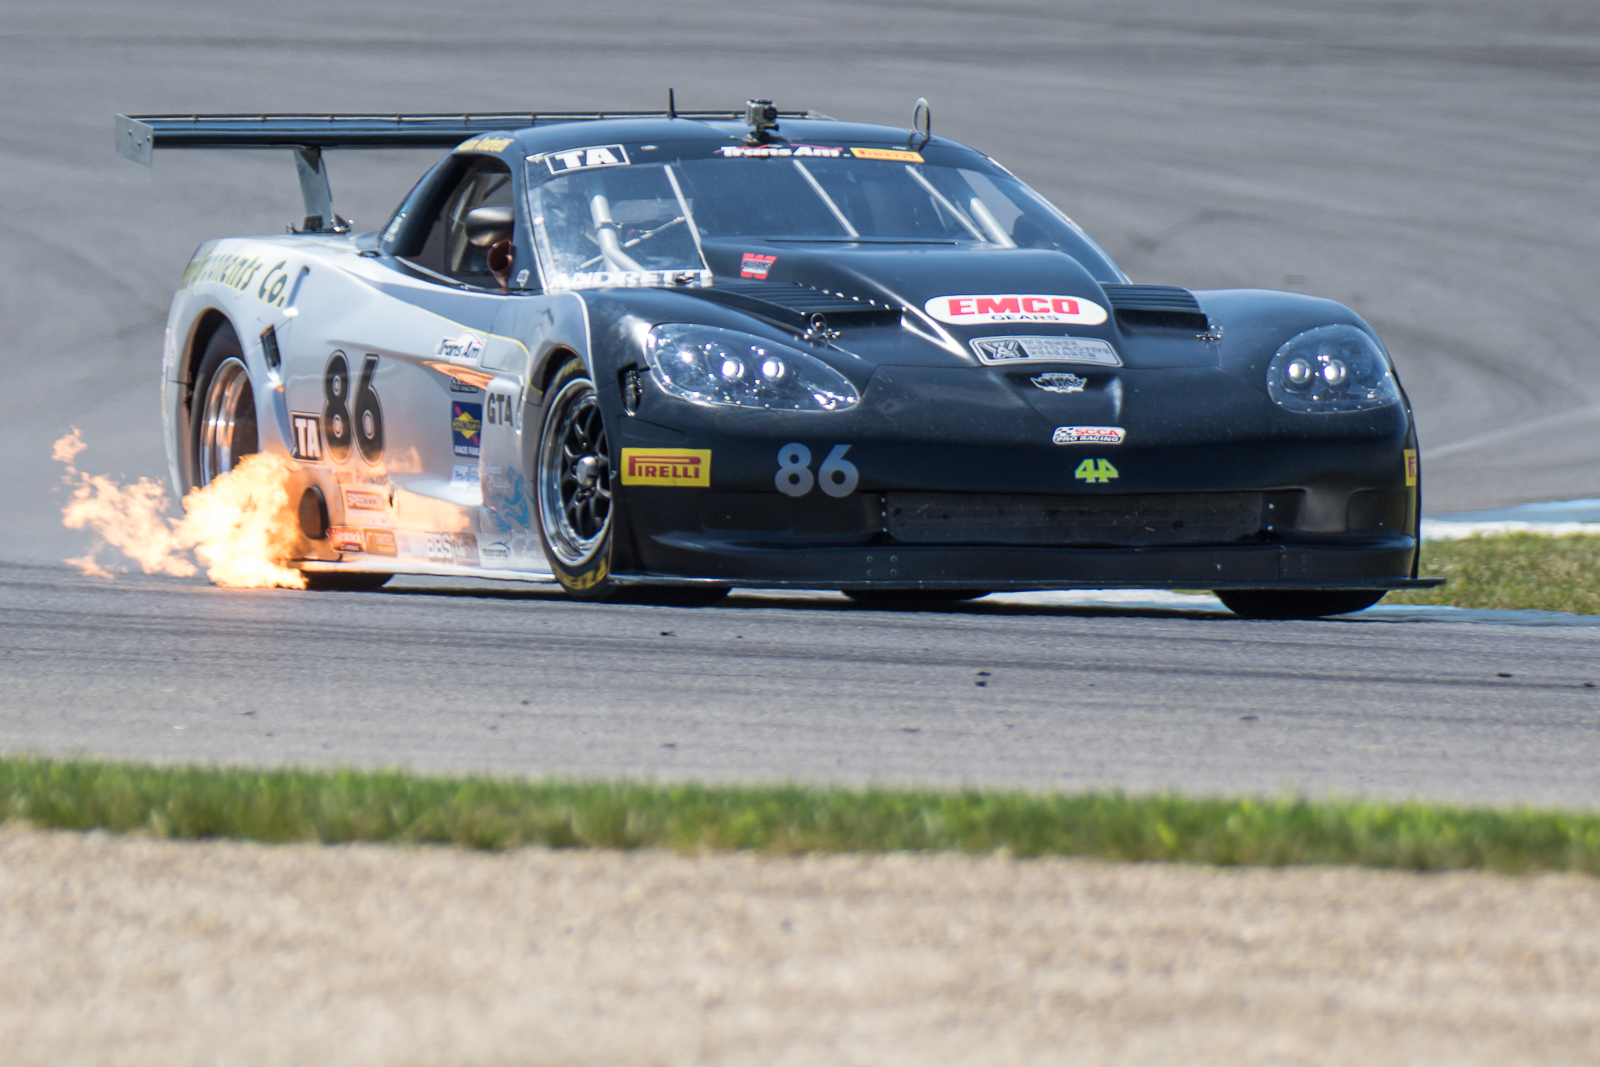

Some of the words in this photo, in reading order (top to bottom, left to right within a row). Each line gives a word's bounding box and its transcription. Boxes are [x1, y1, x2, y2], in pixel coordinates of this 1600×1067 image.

[554, 148, 619, 169] TA
[720, 146, 792, 158] Trans
[793, 146, 840, 158] Am
[948, 297, 1080, 316] EMCO
[990, 313, 1060, 321] GEARS
[437, 339, 463, 357] Trans
[461, 340, 480, 359] Am
[322, 349, 385, 467] 86
[486, 392, 514, 427] GTA
[294, 417, 321, 459] TA
[1074, 429, 1119, 437] SCCA
[628, 455, 702, 479] PIRELLI
[774, 442, 859, 498] 86
